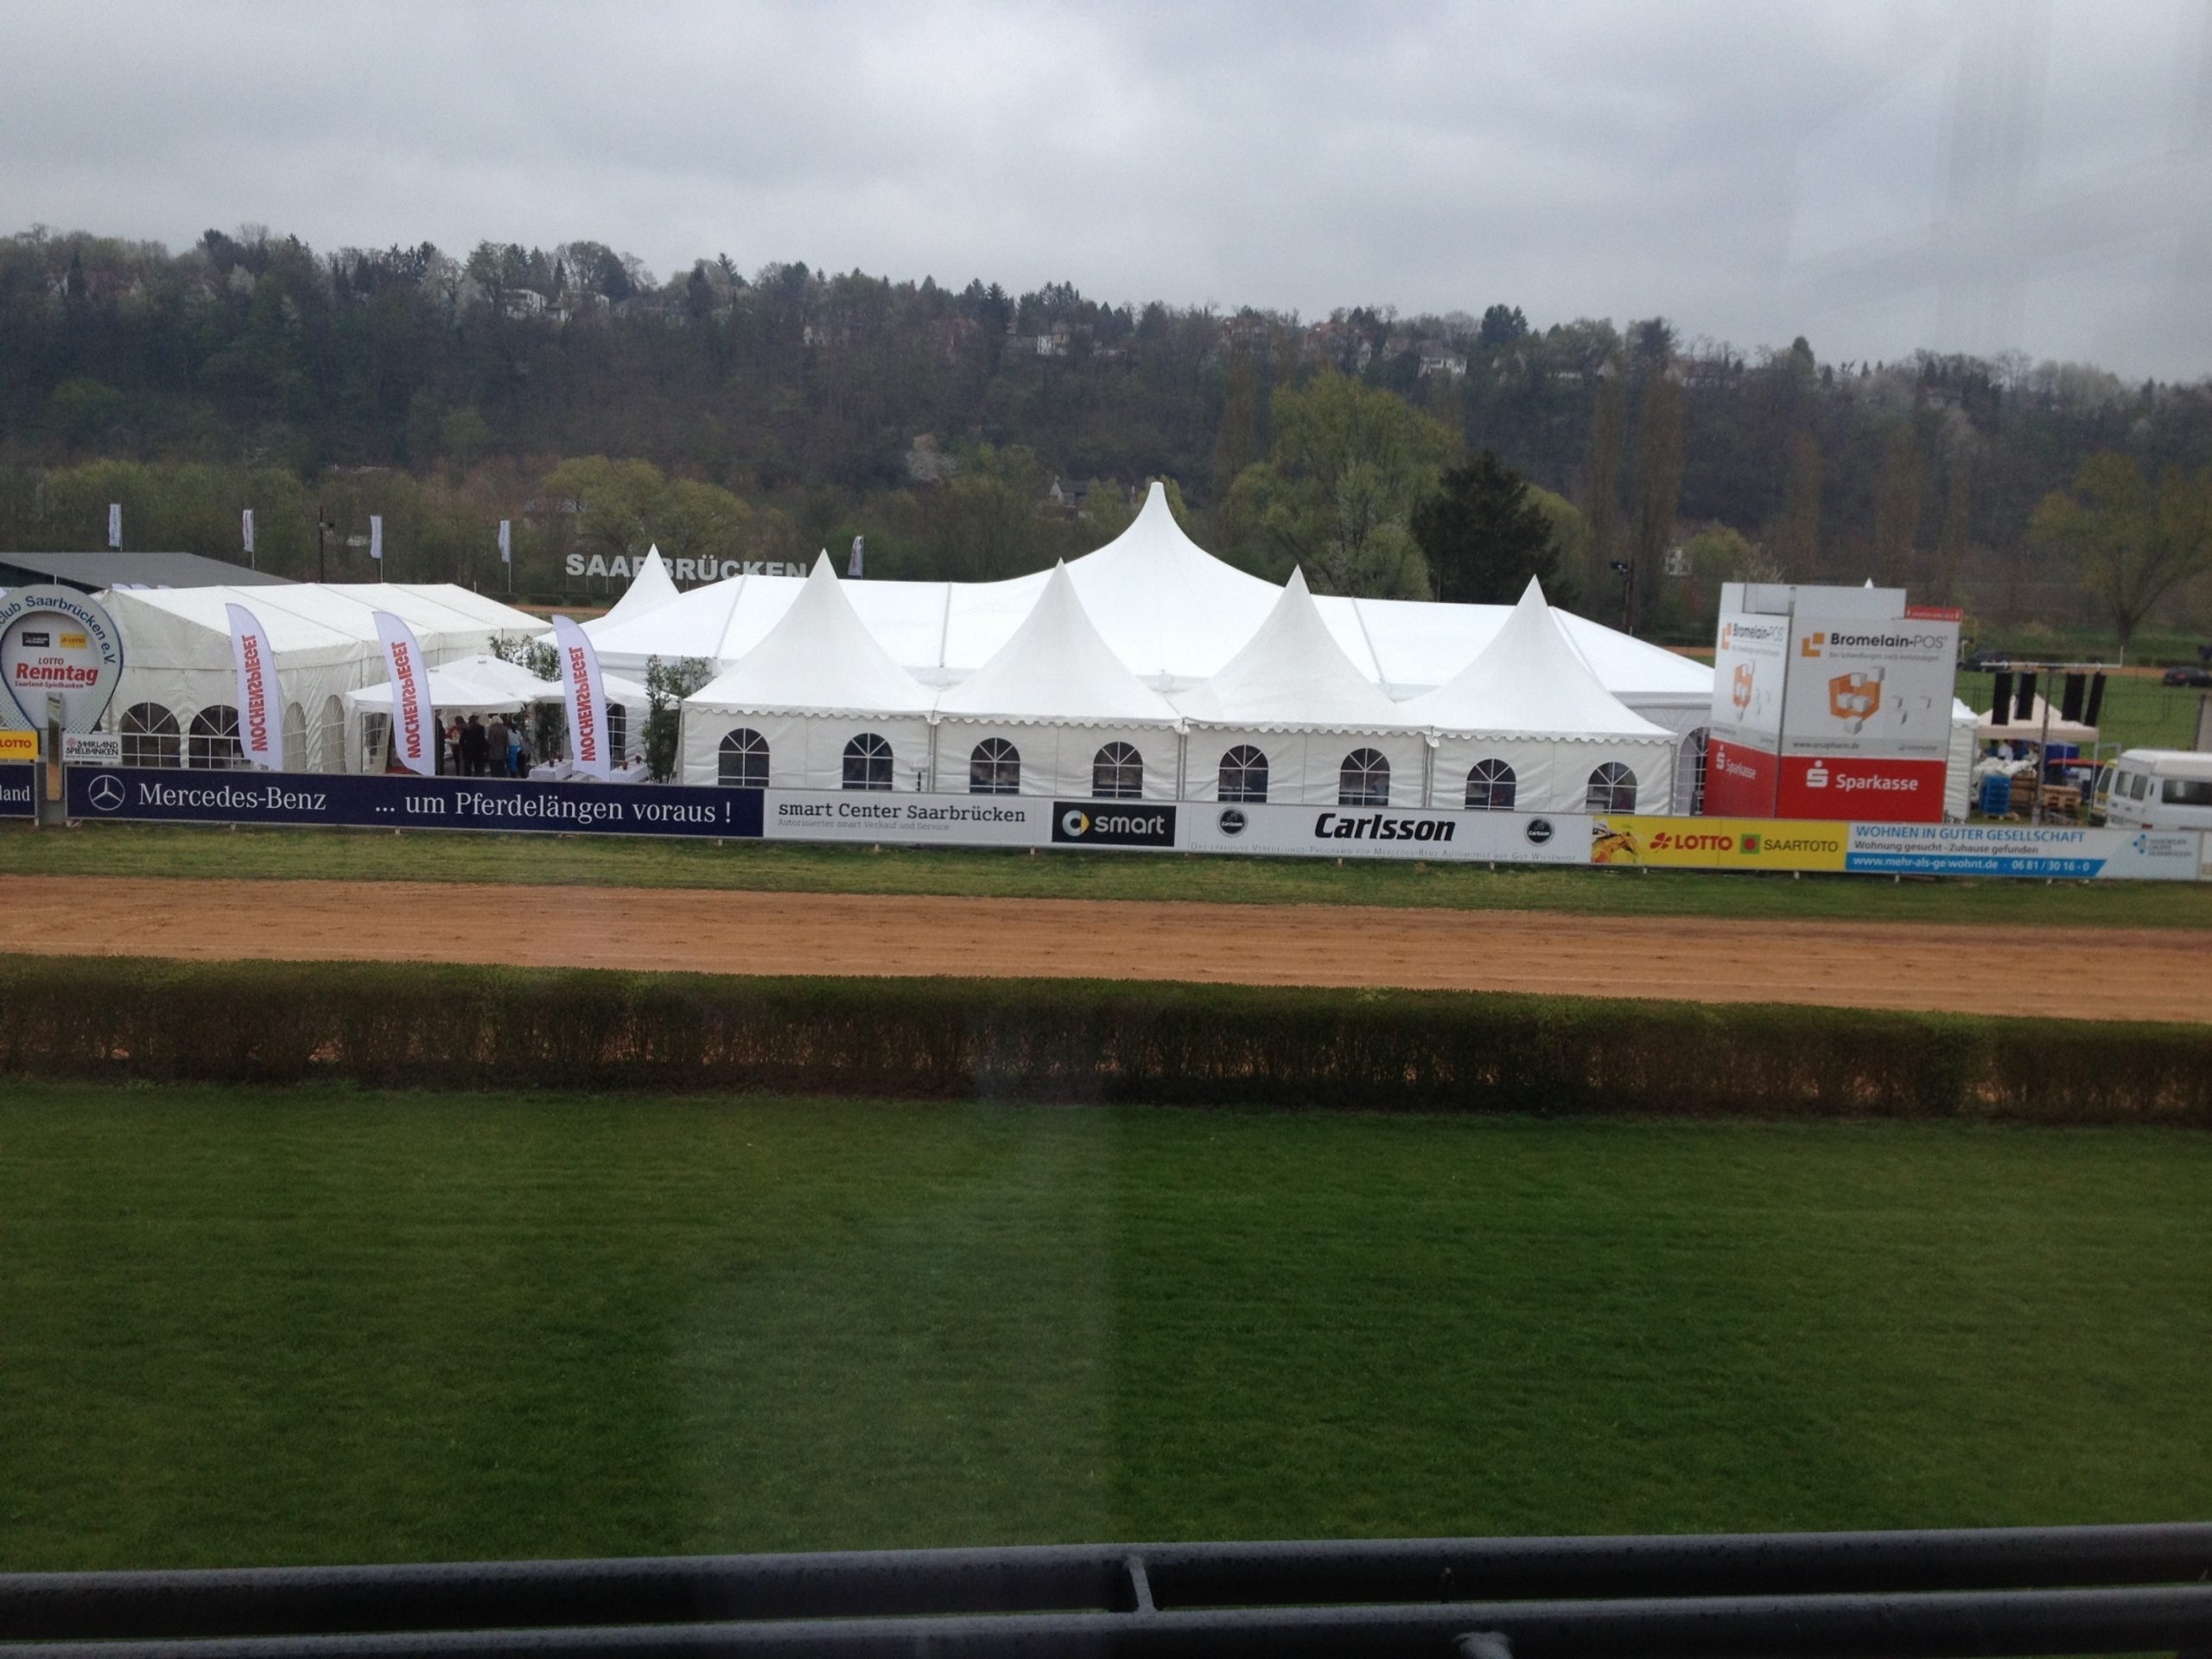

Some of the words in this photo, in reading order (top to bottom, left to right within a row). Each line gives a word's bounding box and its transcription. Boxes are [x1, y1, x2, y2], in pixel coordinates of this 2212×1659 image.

[25, 595, 105, 640] Saarbrücken
[16, 663, 99, 686] Renntag
[66, 747, 118, 756] SPIELBANKEN
[78, 741, 118, 749] SAARLAND
[1836, 773, 1918, 791] Sparkasse
[139, 783, 327, 810] Mercedes-Benz
[405, 796, 446, 814] um
[455, 792, 624, 824] Pferdelängen
[632, 802, 715, 823] voraus
[779, 804, 832, 817] smart
[838, 804, 901, 818] Center
[907, 805, 1026, 822] Saarbrücken
[1095, 813, 1165, 835] smart
[1314, 812, 1456, 842] Carlsson
[1675, 835, 1732, 850] LOTTO
[1764, 839, 1839, 852] SAARTOTO
[1856, 826, 1919, 838] WOHNEN
[1923, 828, 1936, 838] IN
[1939, 828, 1983, 840] GUTER
[1986, 830, 2085, 843] GESELLSCHAFT
[1854, 841, 1902, 852] Wohnung
[1904, 842, 1942, 853] gesucht
[1948, 843, 1988, 854] Zuhause
[1992, 844, 2038, 855] gefunden
